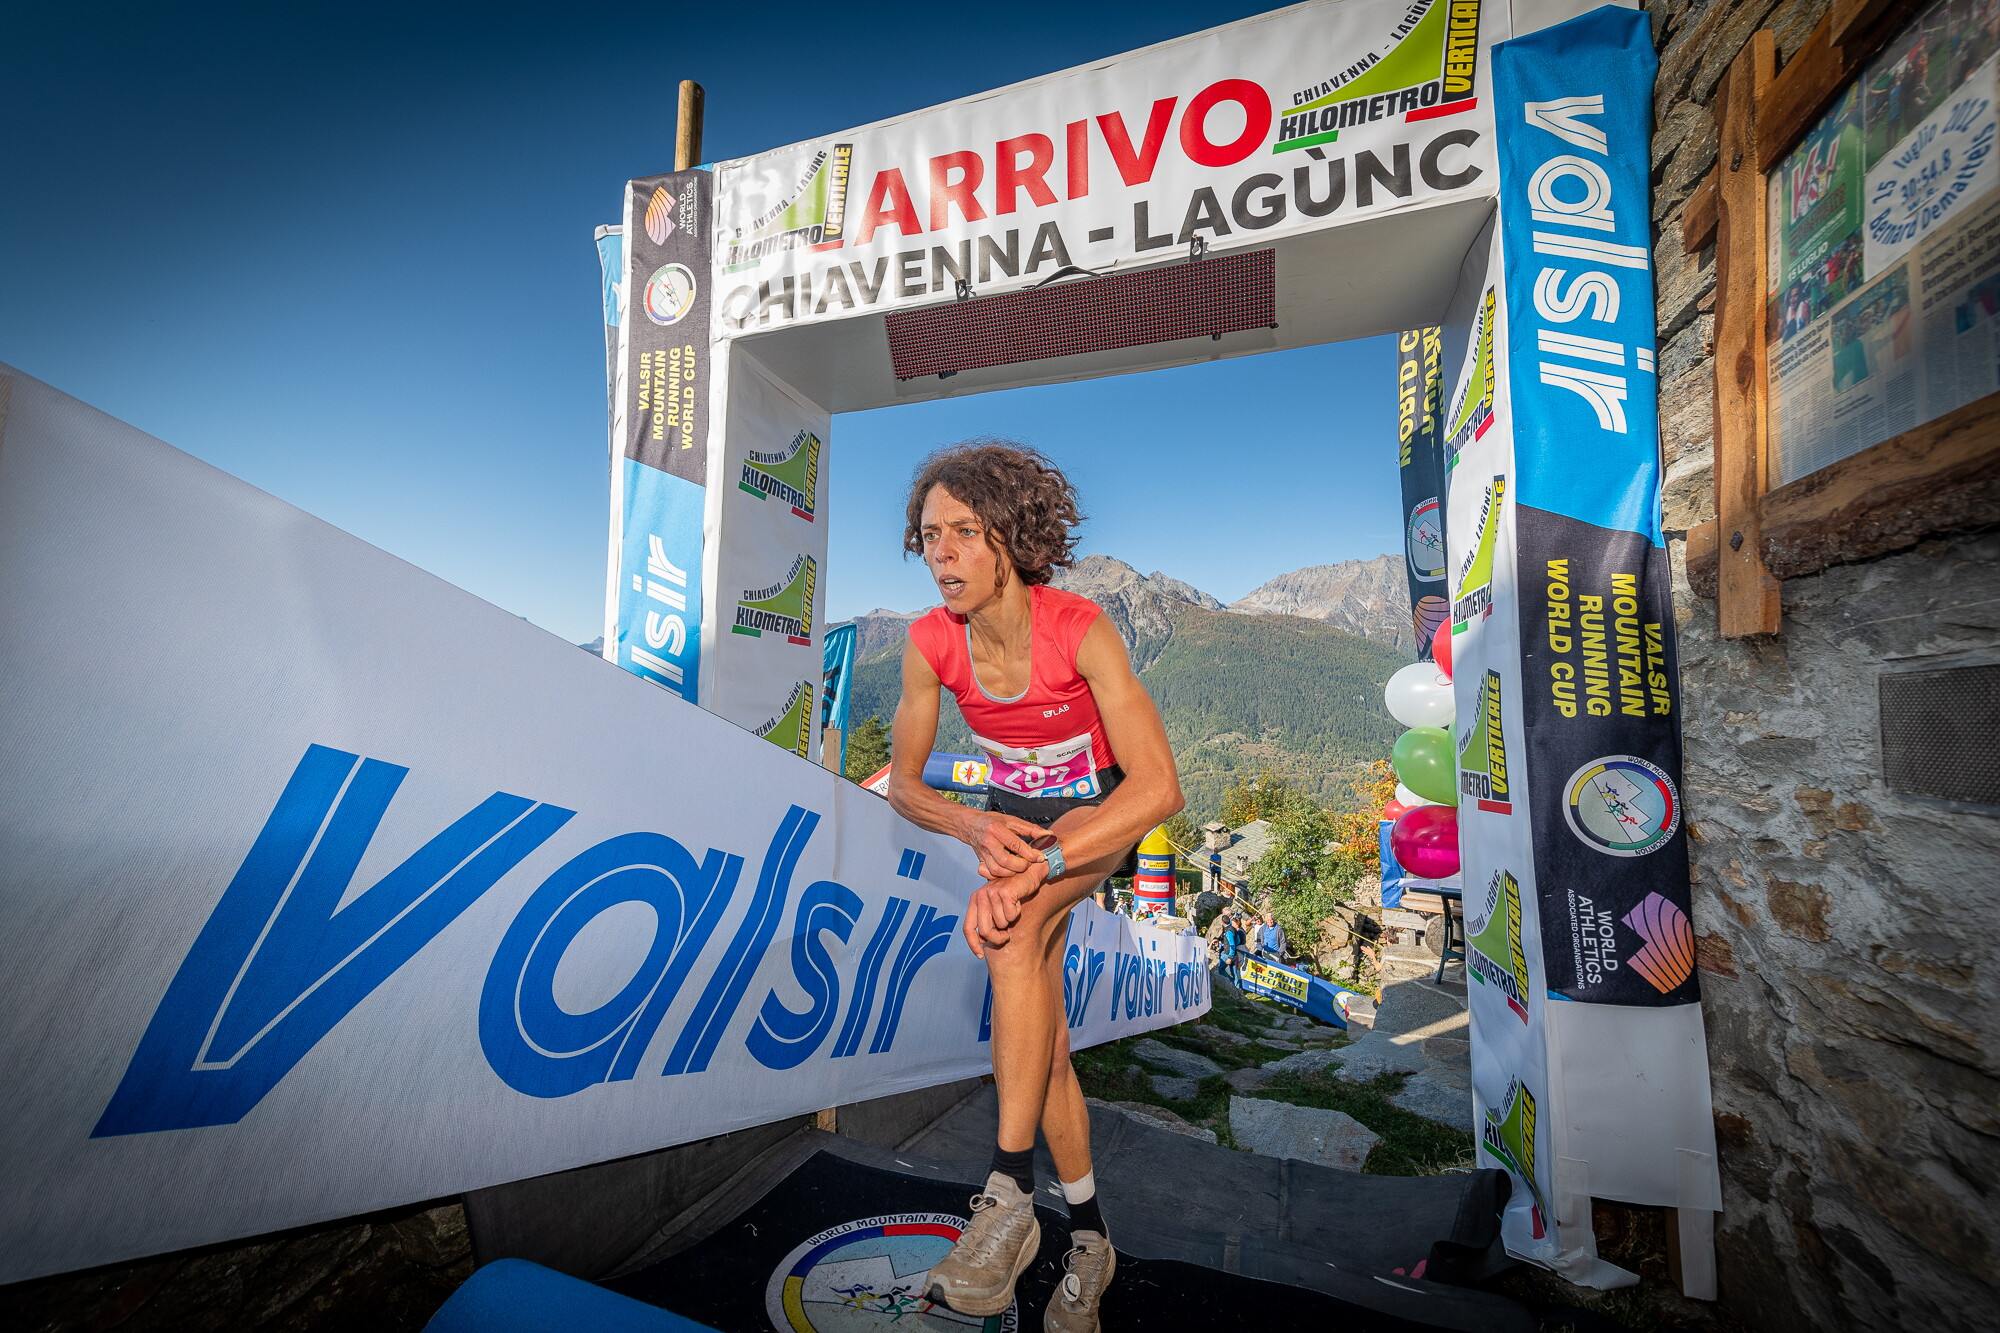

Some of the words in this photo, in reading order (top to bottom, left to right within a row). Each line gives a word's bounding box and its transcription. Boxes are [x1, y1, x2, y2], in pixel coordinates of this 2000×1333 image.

[1293, 52, 1380, 105] CHIAVENNA
[1390, 0, 1433, 41] LAGÙ
[1445, 0, 1479, 93] VERTICA
[1279, 81, 1440, 142] KILOMETRO
[825, 147, 851, 236] VERTICALE
[854, 78, 1272, 247] ARRIVO
[1869, 207, 1919, 245] Bernard
[1922, 122, 1997, 231] Dematteis
[1872, 180, 1897, 204] 15
[679, 193, 687, 229] WORLD
[721, 220, 1072, 331] CHIAVENNA
[1134, 129, 1482, 253] LAGÙNC
[727, 225, 823, 265] KILOMETRO
[1525, 94, 1655, 434] valsir
[1796, 241, 1828, 276] LUGLIO
[638, 352, 652, 411] VALSIR
[667, 347, 681, 427] RUNNING
[683, 344, 696, 380] CUP
[652, 350, 666, 441] MOUNTAIN
[682, 385, 695, 450] WORLD
[742, 464, 804, 509] KILOMETRO
[749, 450, 786, 464] CHIAVENNA
[805, 436, 820, 510] VERTICALE
[736, 606, 801, 637] KILOMETRO
[743, 582, 782, 601] CHIAVENNA
[801, 558, 816, 634] VERTICALE
[1547, 558, 1572, 654] WORLD
[1579, 594, 1612, 716] RUNNING
[1611, 573, 1646, 718] MOUNTAIN
[1643, 623, 1670, 716] VALSIR
[1550, 662, 1577, 718] CUP
[1488, 674, 1508, 796] VERTICALE
[1627, 756, 1651, 769] WORLD
[1652, 767, 1677, 797] MOUNTAIN
[1634, 828, 1674, 856] ASSOCIATION
[1671, 799, 1680, 829] RUNNING
[1505, 876, 1529, 1003] VERTICALE
[1568, 888, 1578, 932] ASSOCIATED
[1578, 895, 1602, 984] ATHLETICS
[1597, 910, 1618, 971] WORLD
[88, 743, 959, 1140] valsir
[1572, 933, 1585, 989] ORGANISATIONS
[1111, 937, 1167, 1021] valsir
[1250, 971, 1304, 996] SPECIALIST
[1268, 970, 1304, 988] SPORT
[806, 1221, 851, 1246] WORLD
[857, 1214, 928, 1228] MOUNTAIN
[932, 1214, 969, 1230] RUNN
